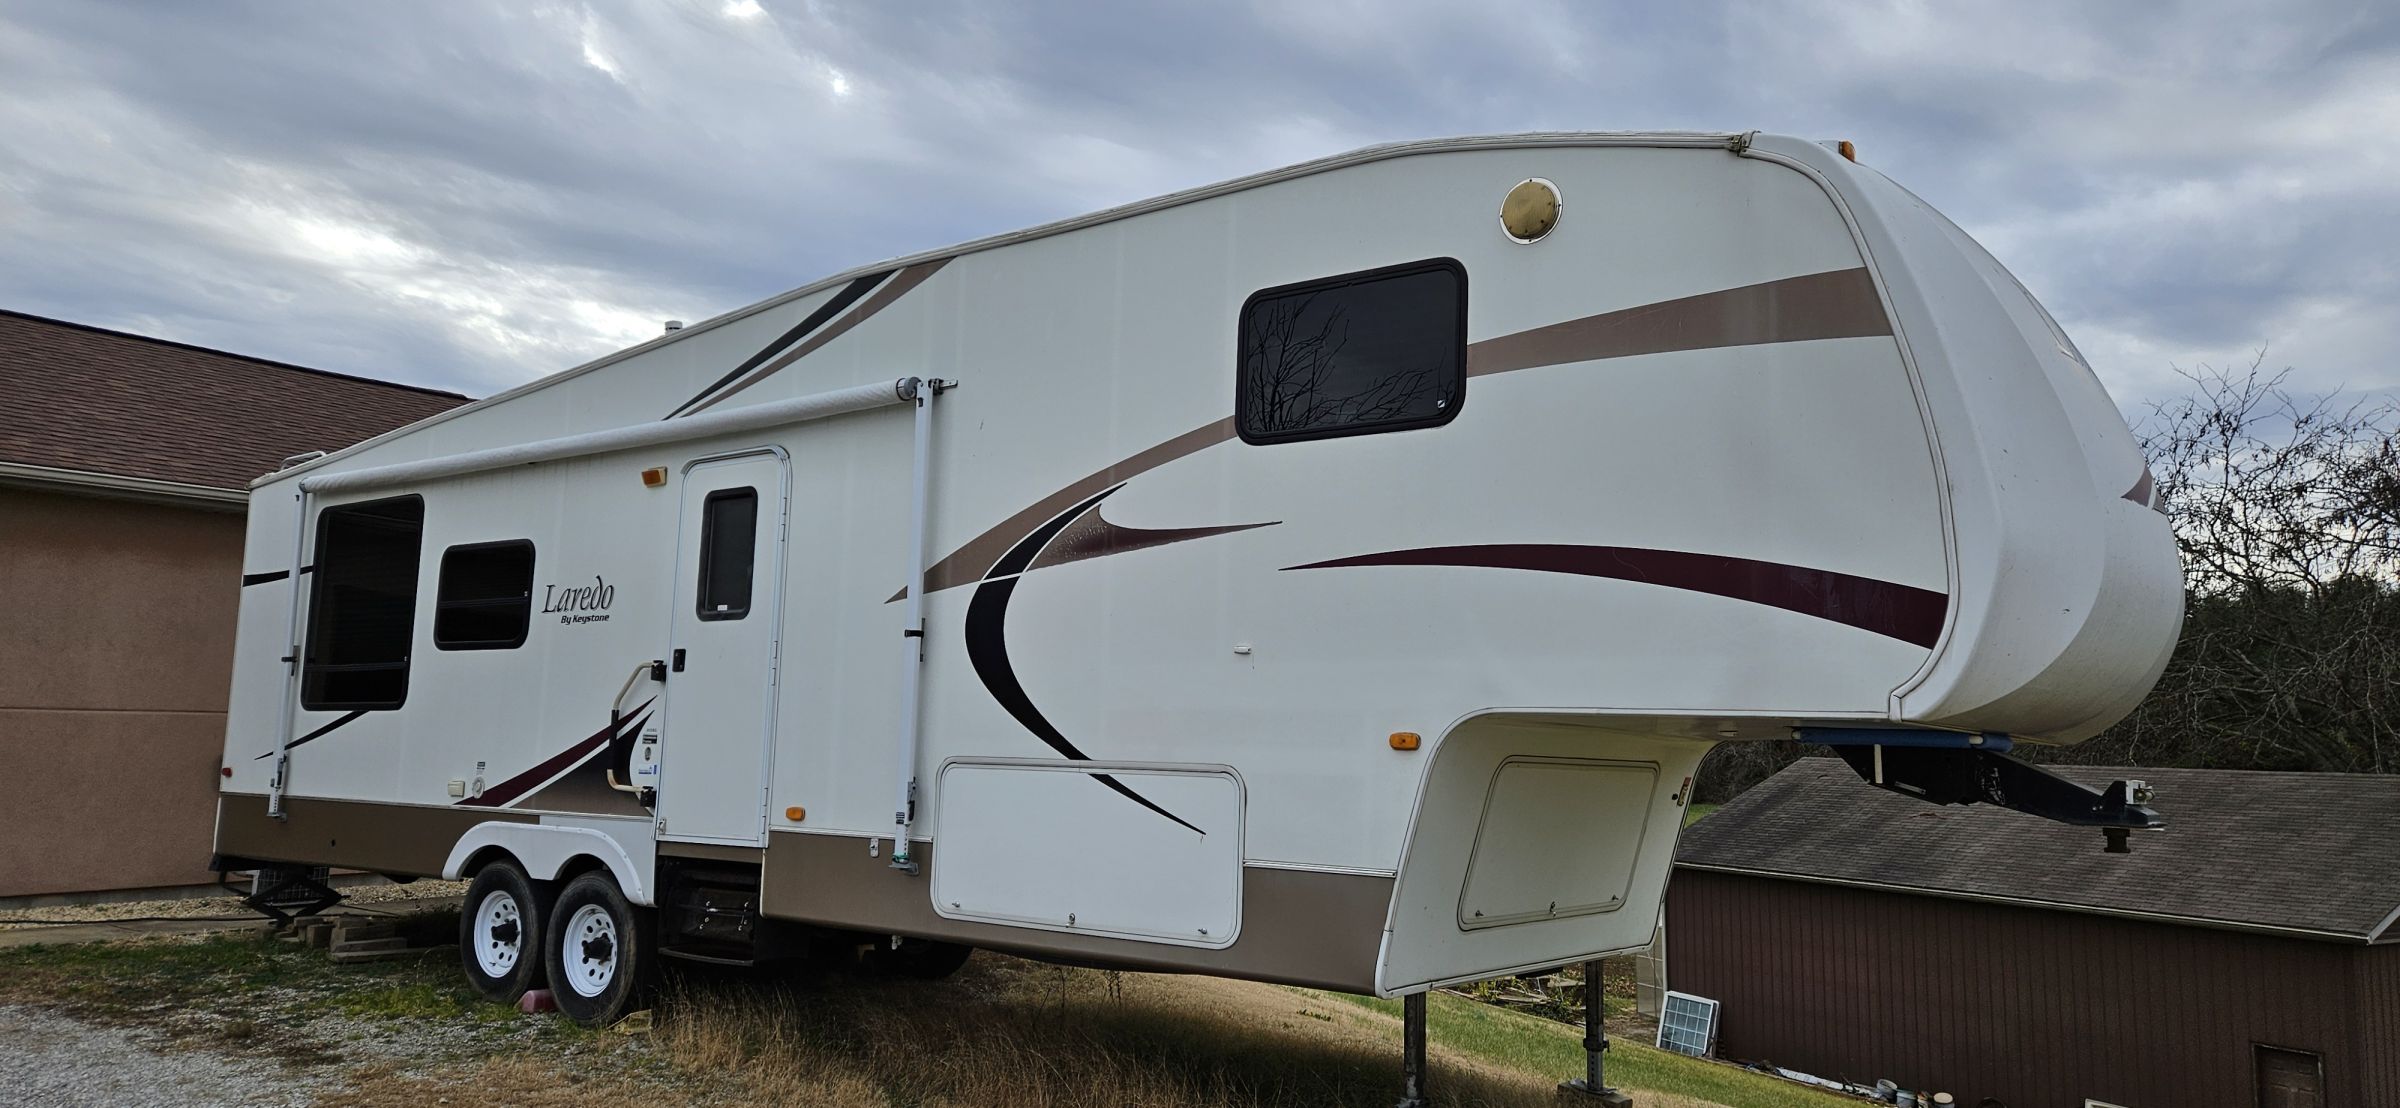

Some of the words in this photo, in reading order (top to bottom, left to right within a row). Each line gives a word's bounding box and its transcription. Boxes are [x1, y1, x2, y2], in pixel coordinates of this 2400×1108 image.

[541, 574, 615, 613] Laredo
[561, 615, 571, 625] By
[573, 614, 610, 624] Keystone
